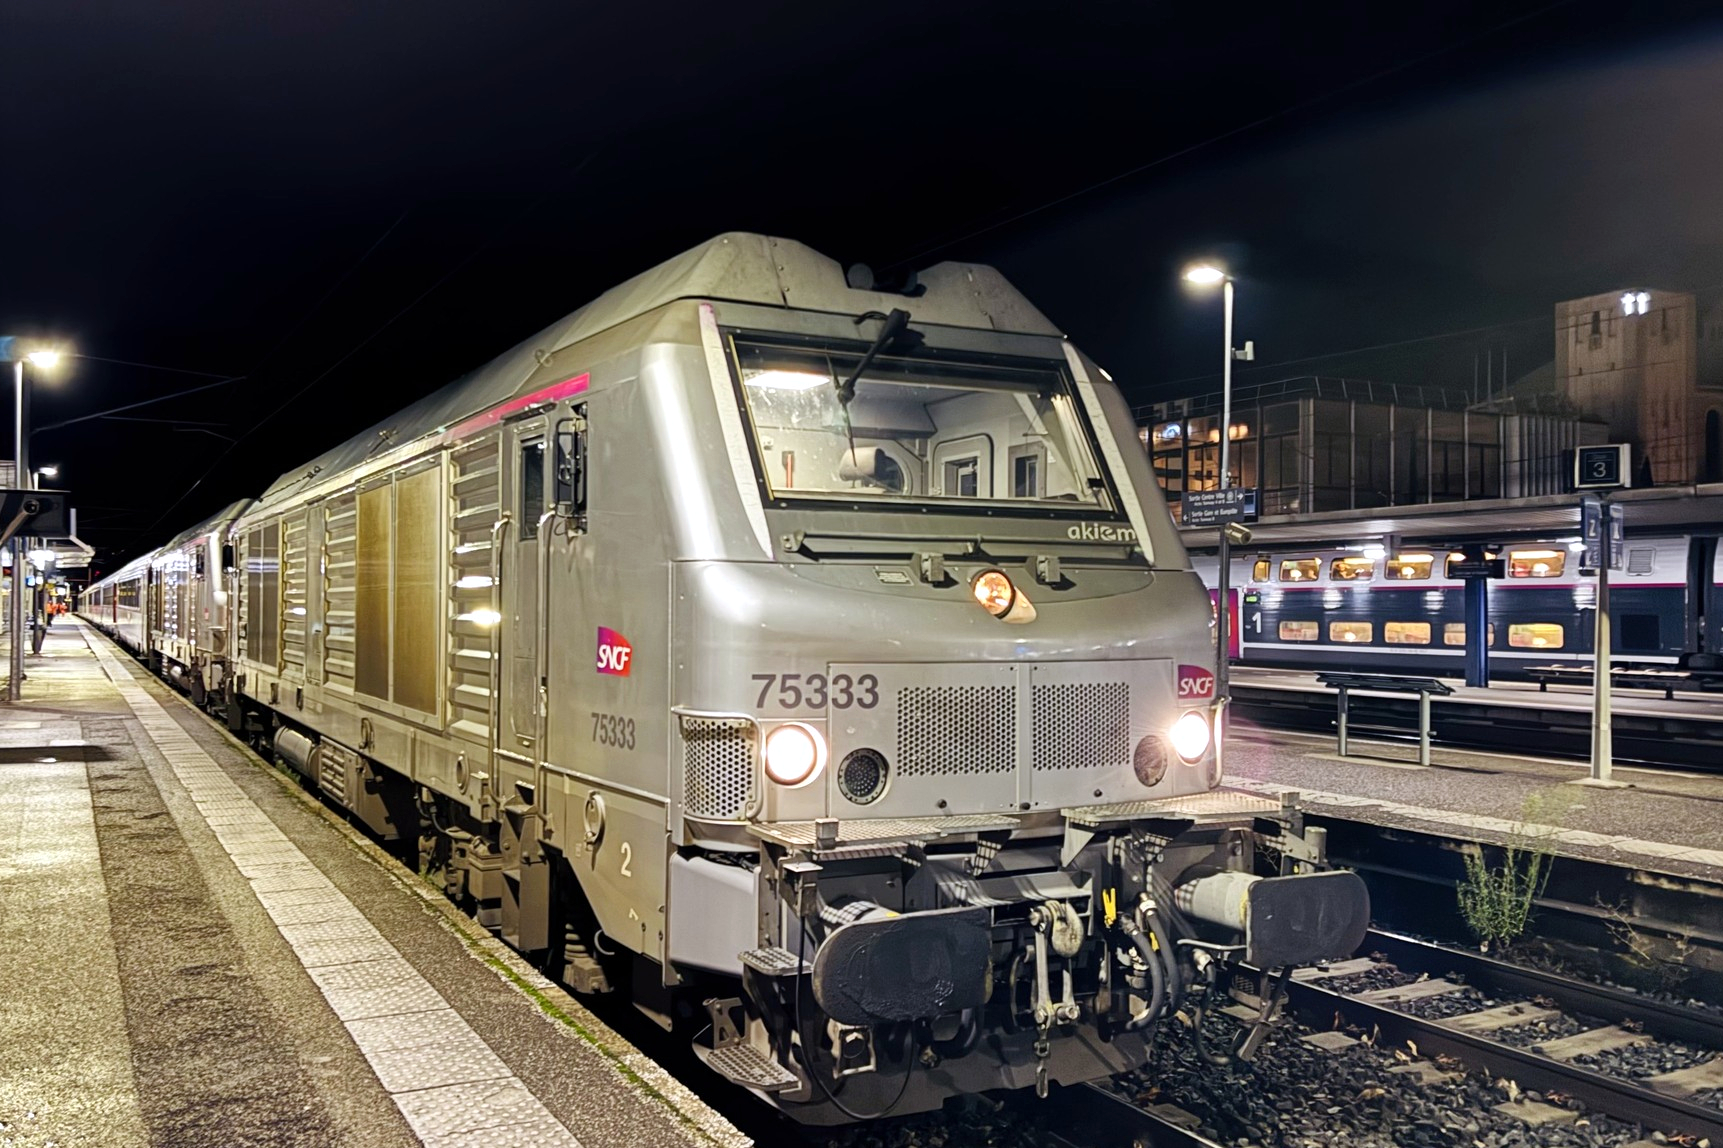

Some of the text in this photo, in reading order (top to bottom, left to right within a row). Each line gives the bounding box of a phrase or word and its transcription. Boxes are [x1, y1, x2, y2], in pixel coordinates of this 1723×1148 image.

[1592, 461, 1606, 478] 3
[1067, 521, 1136, 541] akiem
[1252, 611, 1262, 634] 1
[597, 644, 631, 671] SNCF
[752, 673, 879, 709] 75333
[1178, 676, 1214, 695] SNCF
[591, 711, 636, 751] 75333
[620, 841, 632, 878] 2
